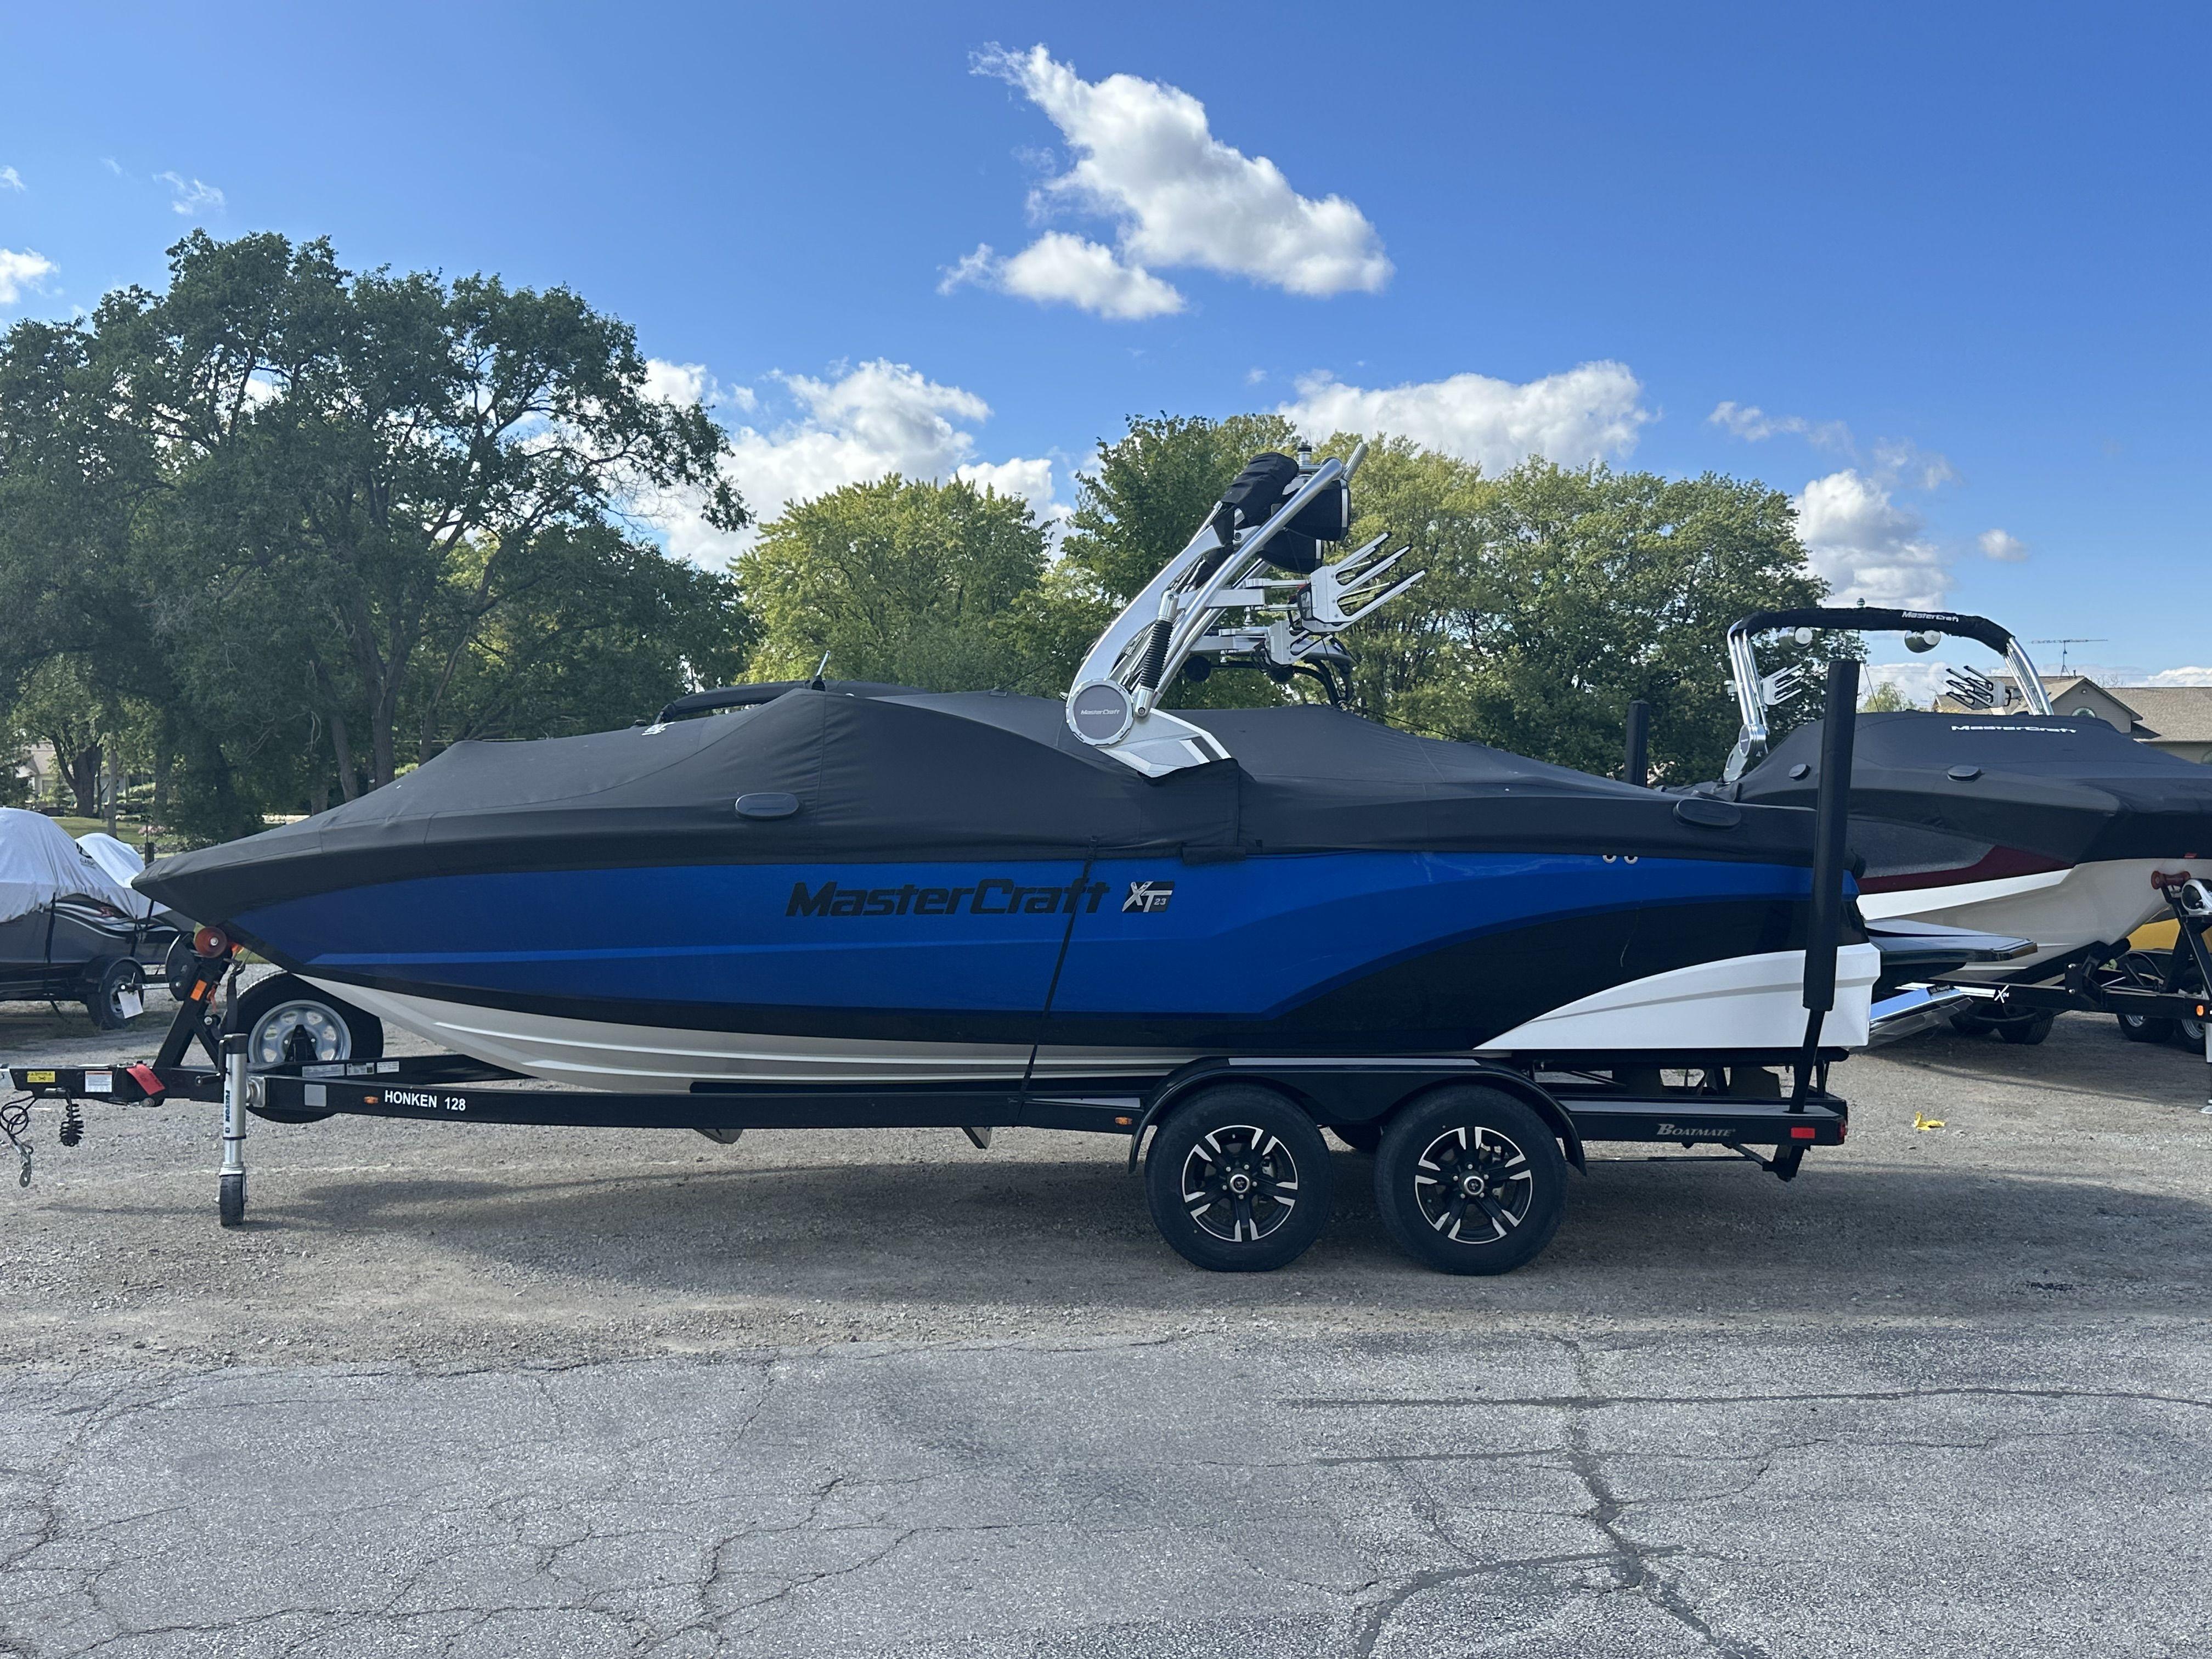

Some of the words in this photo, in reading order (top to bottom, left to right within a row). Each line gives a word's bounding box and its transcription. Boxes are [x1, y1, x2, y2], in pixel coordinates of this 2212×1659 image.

[1901, 611, 1959, 623] MasterCraft
[785, 878, 1110, 917] MasterCraft
[385, 1090, 437, 1108] HONKEN
[444, 1097, 466, 1111] 128
[1656, 1124, 1732, 1137] BOATMATE
